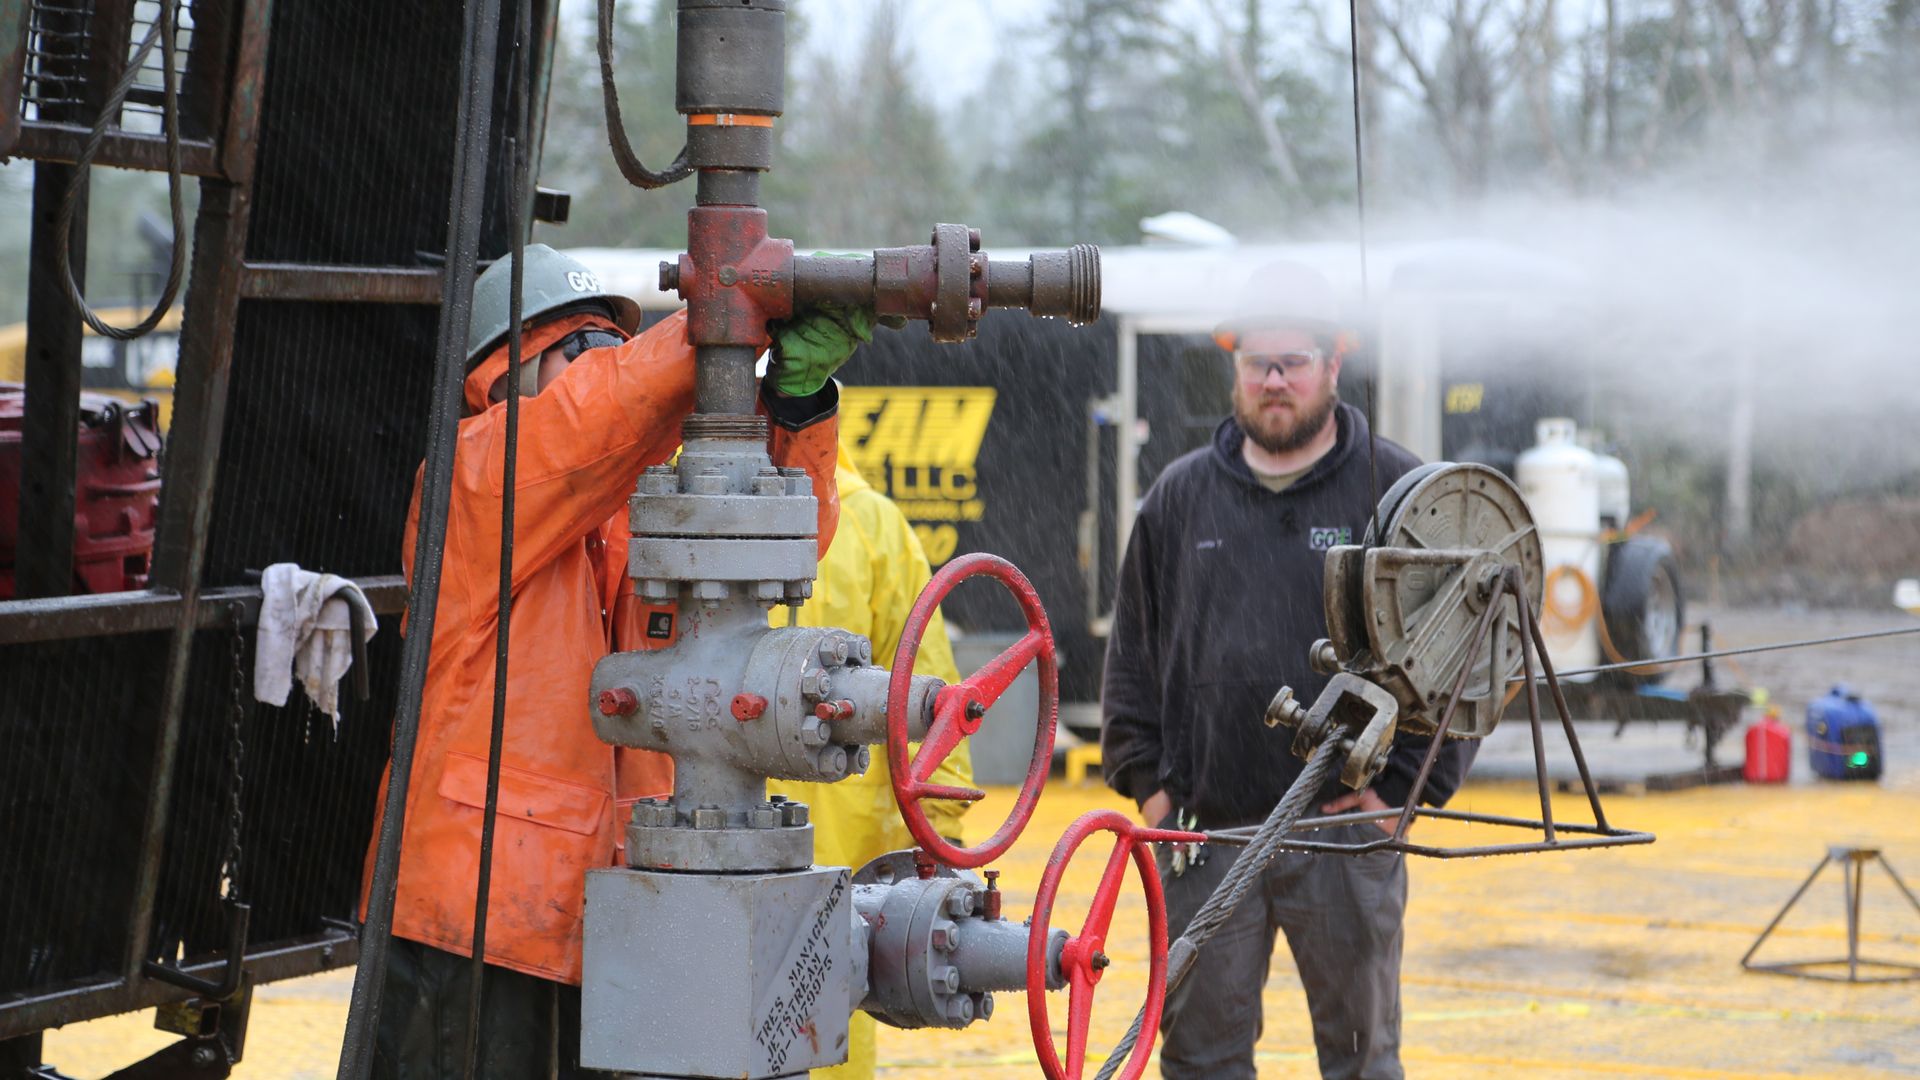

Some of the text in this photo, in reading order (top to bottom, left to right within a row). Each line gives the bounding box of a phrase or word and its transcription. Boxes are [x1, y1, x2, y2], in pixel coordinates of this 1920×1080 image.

[891, 465, 977, 500] LLC
[756, 869, 849, 1046] TRES MANAGEMENT
[768, 952, 821, 1063] JETSTREAM
